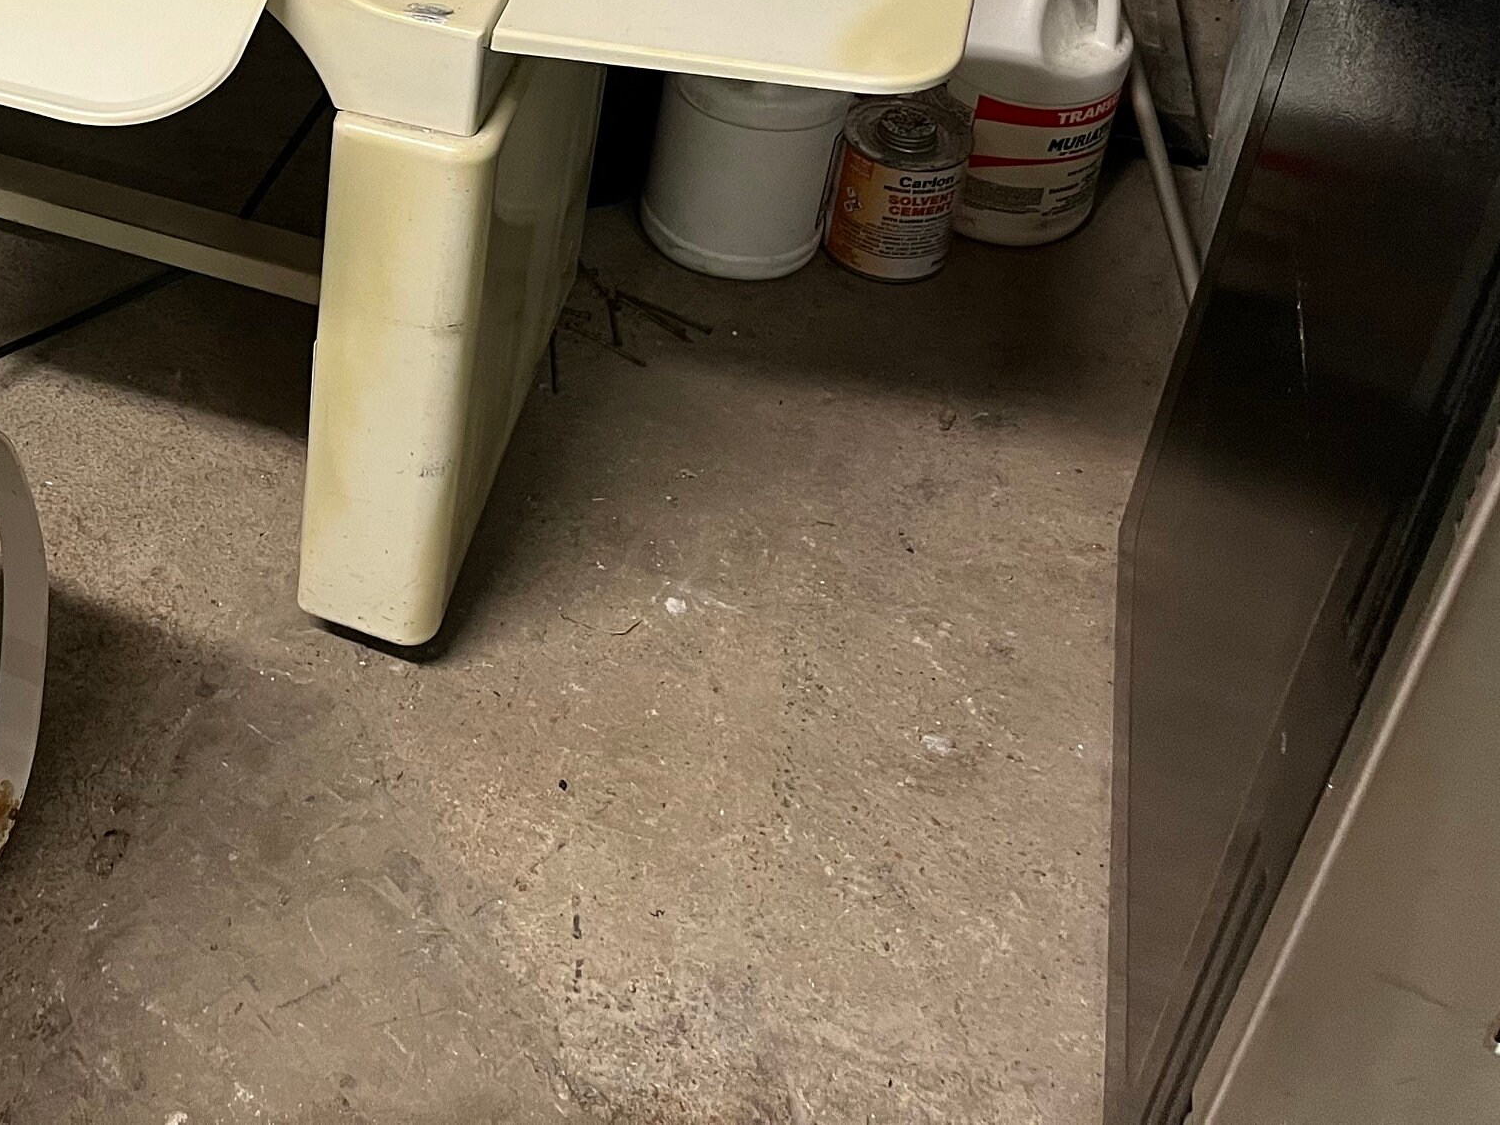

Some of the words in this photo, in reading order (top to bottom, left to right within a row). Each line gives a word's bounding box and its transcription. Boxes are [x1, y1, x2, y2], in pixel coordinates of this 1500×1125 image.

[899, 175, 955, 189] Carlon
[888, 189, 956, 207] SOLVENT
[888, 200, 952, 217] CEMENT
